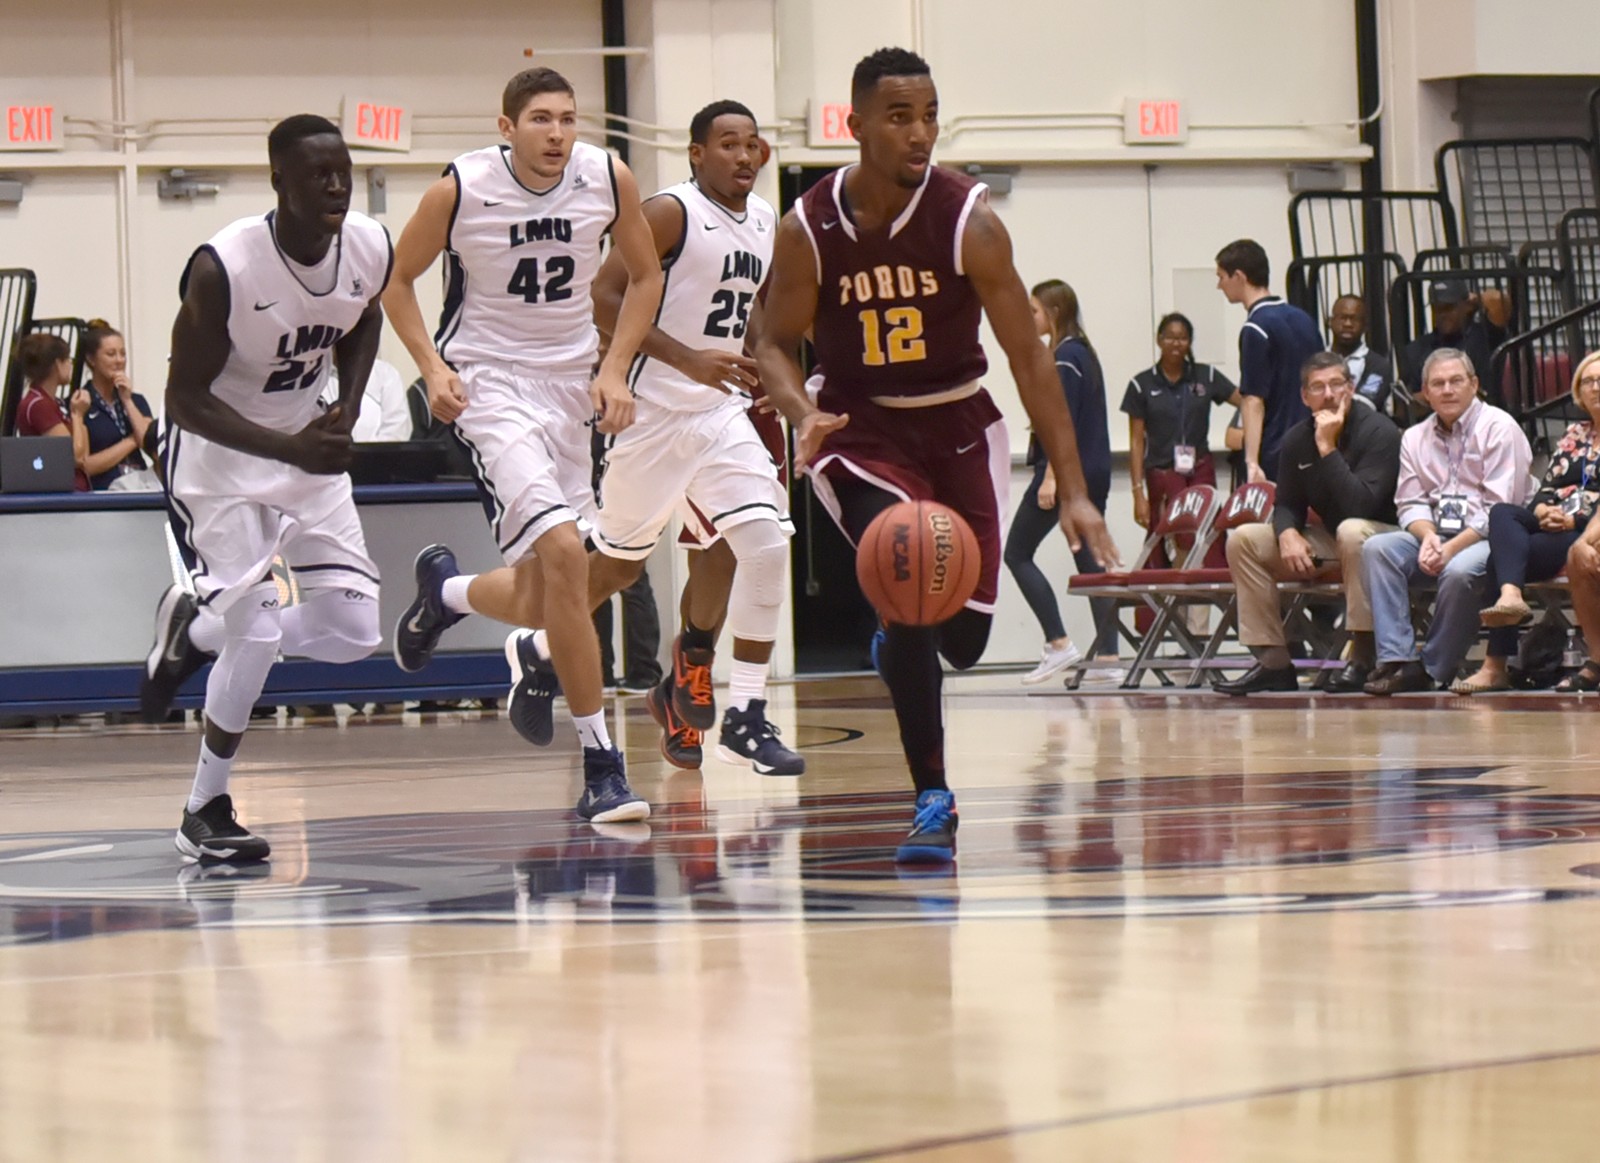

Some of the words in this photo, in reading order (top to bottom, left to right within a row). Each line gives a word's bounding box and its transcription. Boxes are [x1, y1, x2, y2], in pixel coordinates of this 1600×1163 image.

[7, 106, 53, 142] EXIT
[357, 103, 402, 142] EXIT
[822, 103, 854, 140] EX
[1138, 101, 1180, 137] EXIT
[510, 217, 572, 248] LMU
[507, 255, 575, 304] 42
[720, 250, 763, 286] LMU
[703, 288, 754, 339] 25
[276, 324, 344, 359] LMU
[858, 306, 927, 367] 12
[1168, 491, 1205, 523] LMU
[1228, 487, 1268, 520] LMU
[892, 523, 912, 583] NCAA
[928, 511, 955, 595] Wilson
